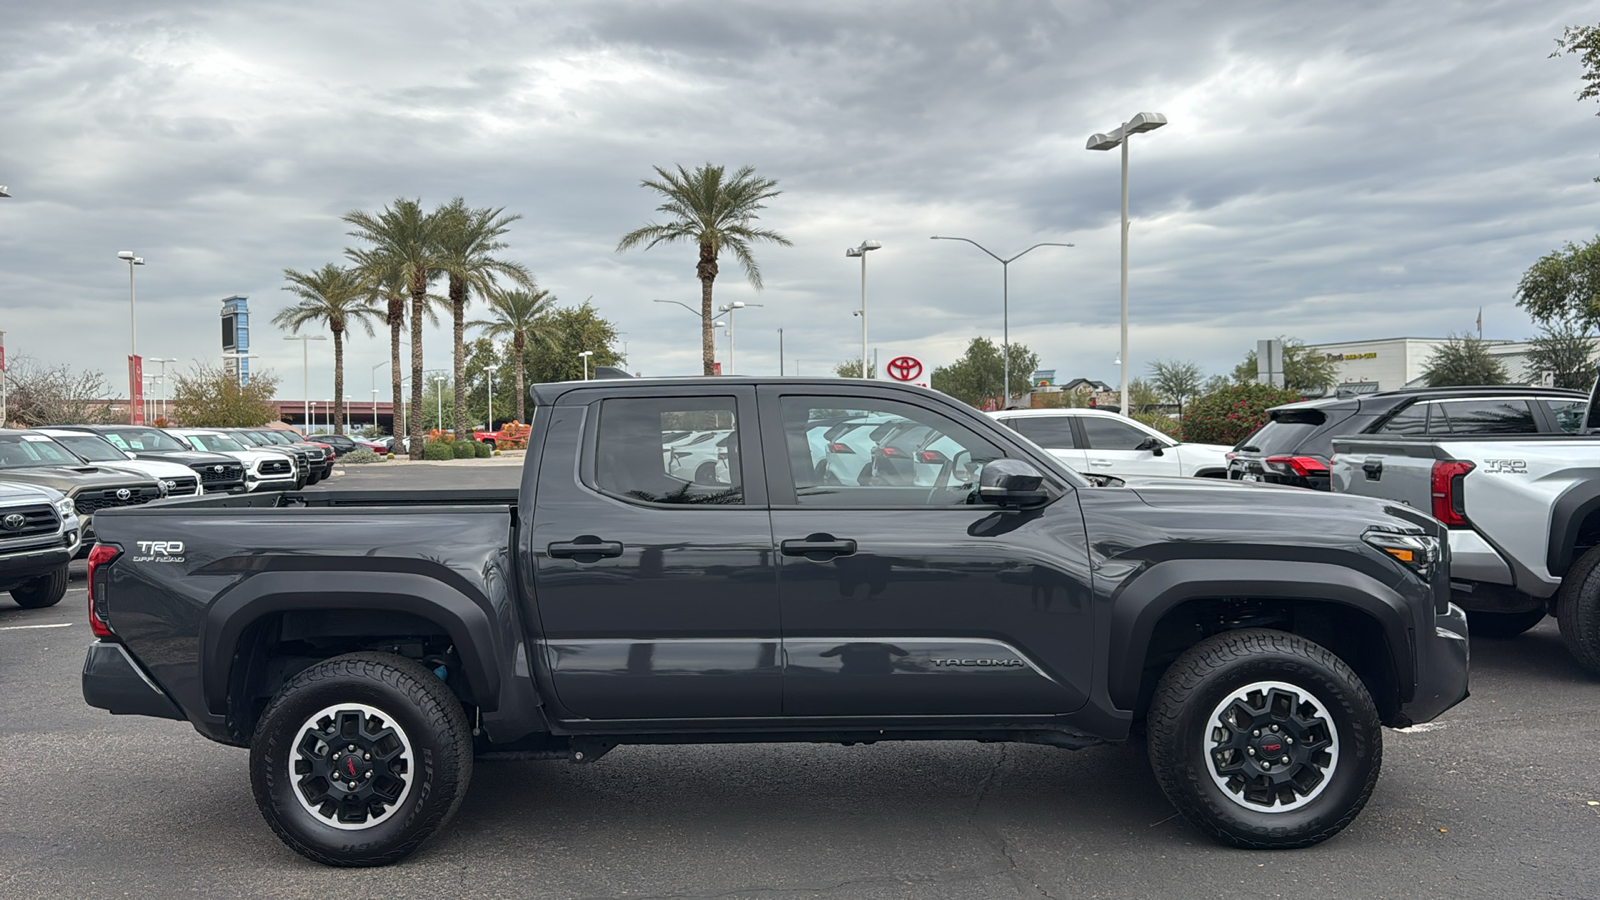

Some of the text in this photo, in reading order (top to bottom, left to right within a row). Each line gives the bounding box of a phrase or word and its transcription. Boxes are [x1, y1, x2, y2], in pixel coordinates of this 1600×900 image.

[1484, 459, 1527, 471] TRD
[136, 541, 185, 556] TRD
[155, 555, 185, 563] ROAD
[930, 658, 1025, 667] TACOMA
[1261, 743, 1282, 752] TRD
[347, 758, 357, 776] TRD
